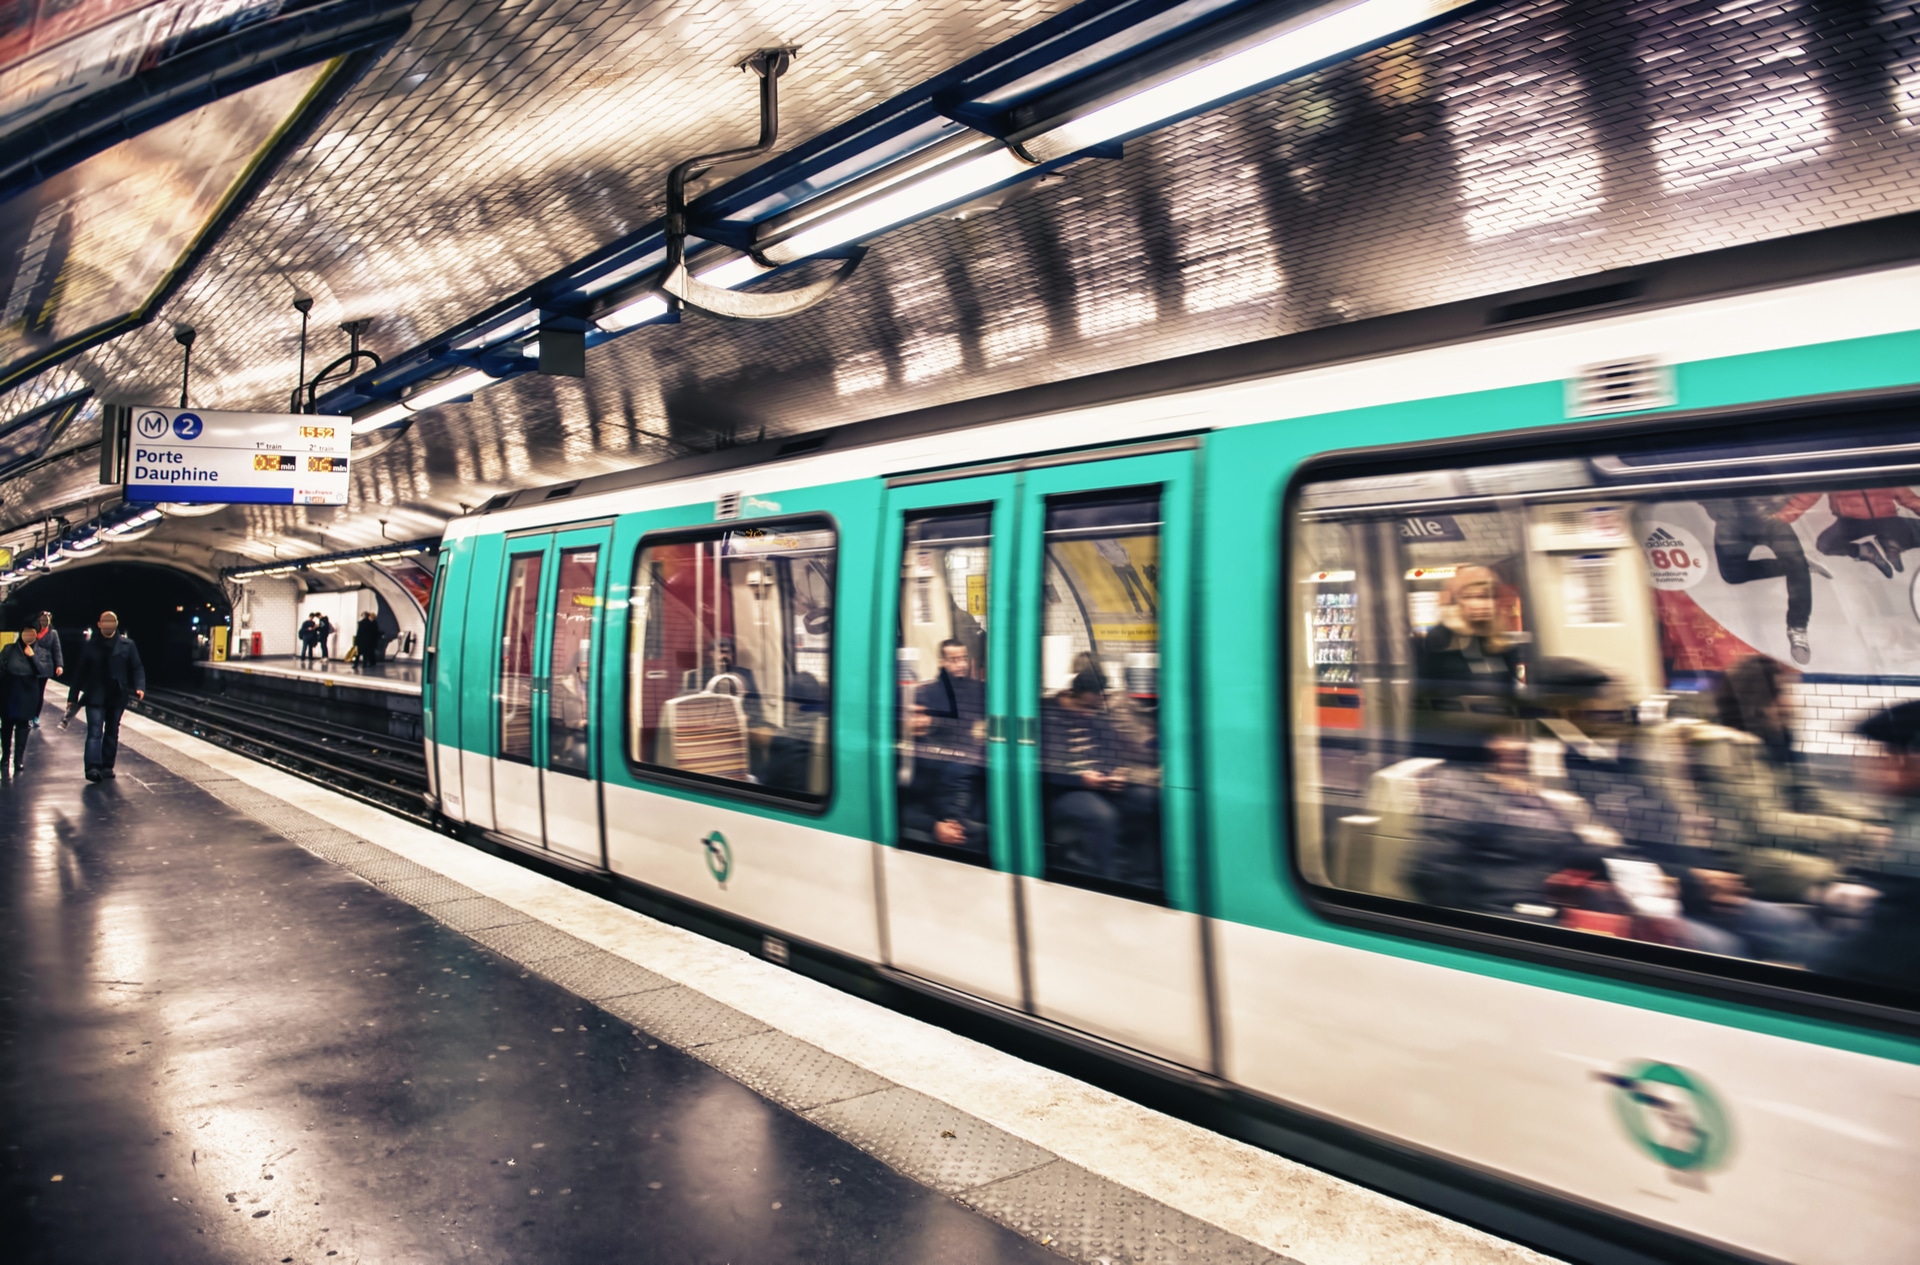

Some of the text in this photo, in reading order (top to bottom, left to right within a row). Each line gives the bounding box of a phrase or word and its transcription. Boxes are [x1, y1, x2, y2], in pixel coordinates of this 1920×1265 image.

[181, 418, 195, 435] 2
[136, 449, 183, 463] Porte
[280, 462, 295, 470] min
[332, 464, 347, 472] min
[135, 466, 219, 484] Dauphine
[1645, 540, 1684, 548] adidas
